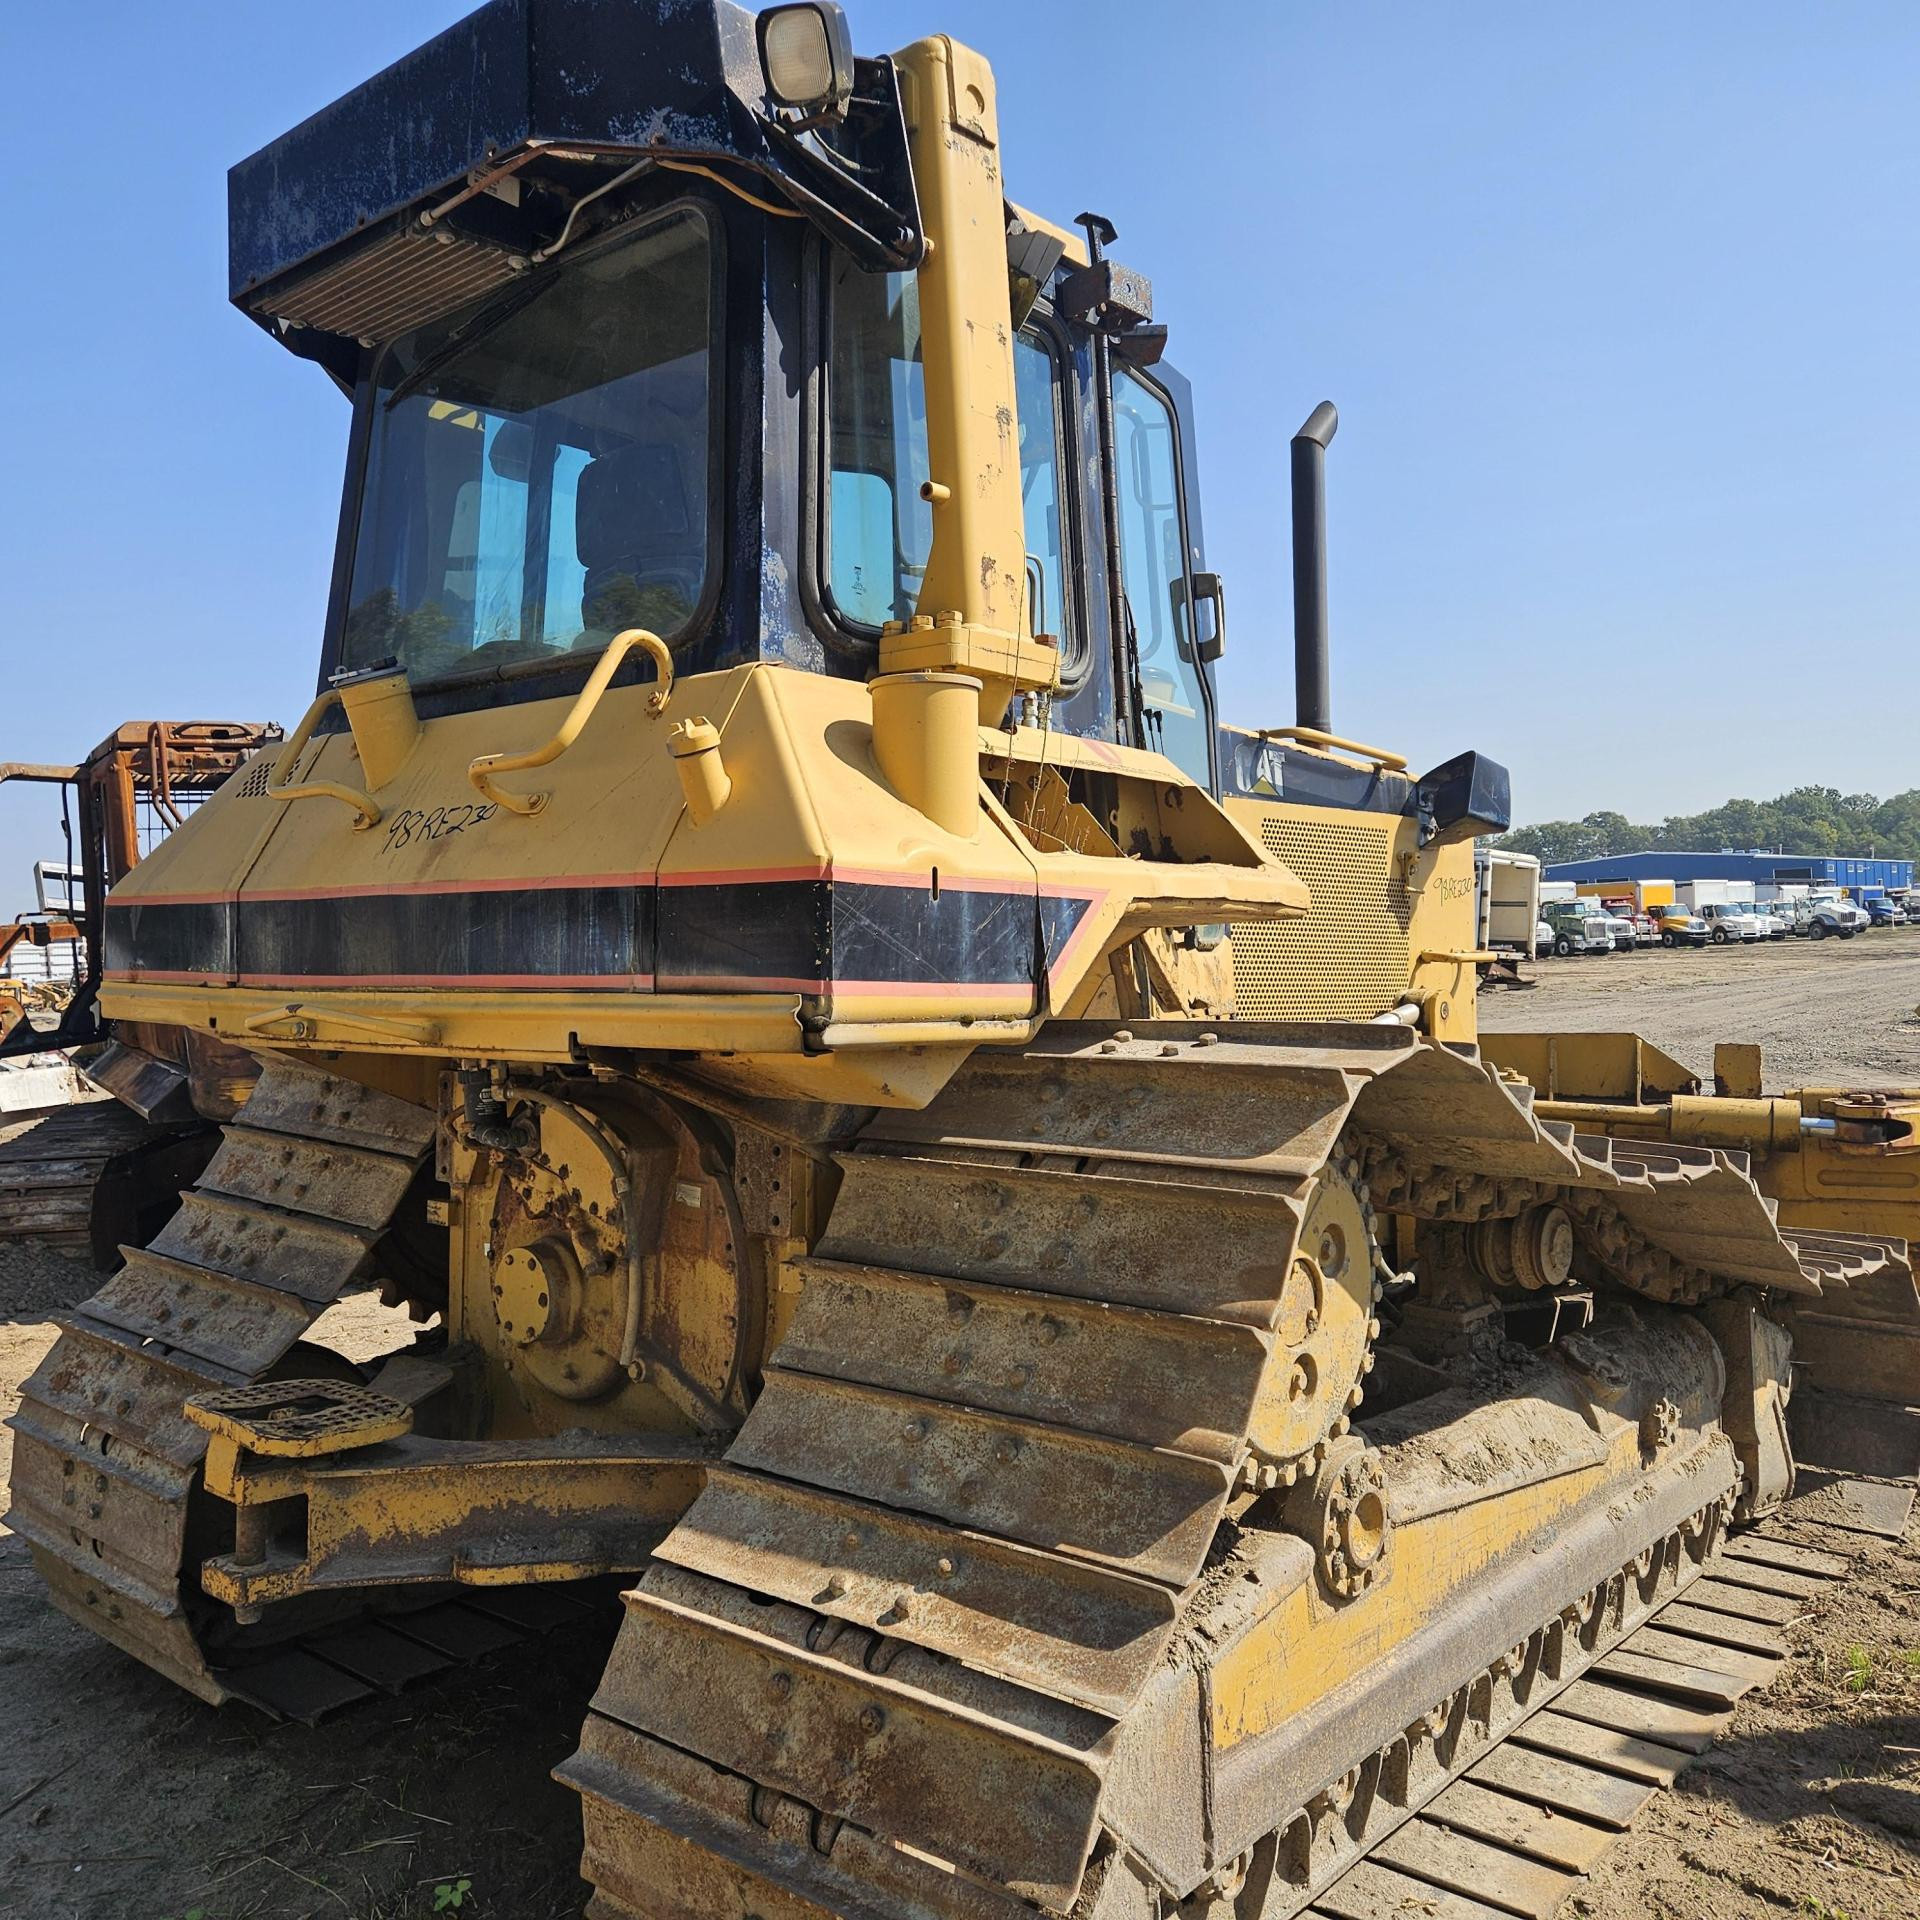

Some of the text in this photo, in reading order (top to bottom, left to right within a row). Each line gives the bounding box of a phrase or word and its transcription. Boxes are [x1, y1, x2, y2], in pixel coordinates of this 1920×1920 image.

[1234, 742, 1286, 797] CAT
[381, 802, 499, 855] 98RE230
[1433, 877, 1473, 907] 98RE230
